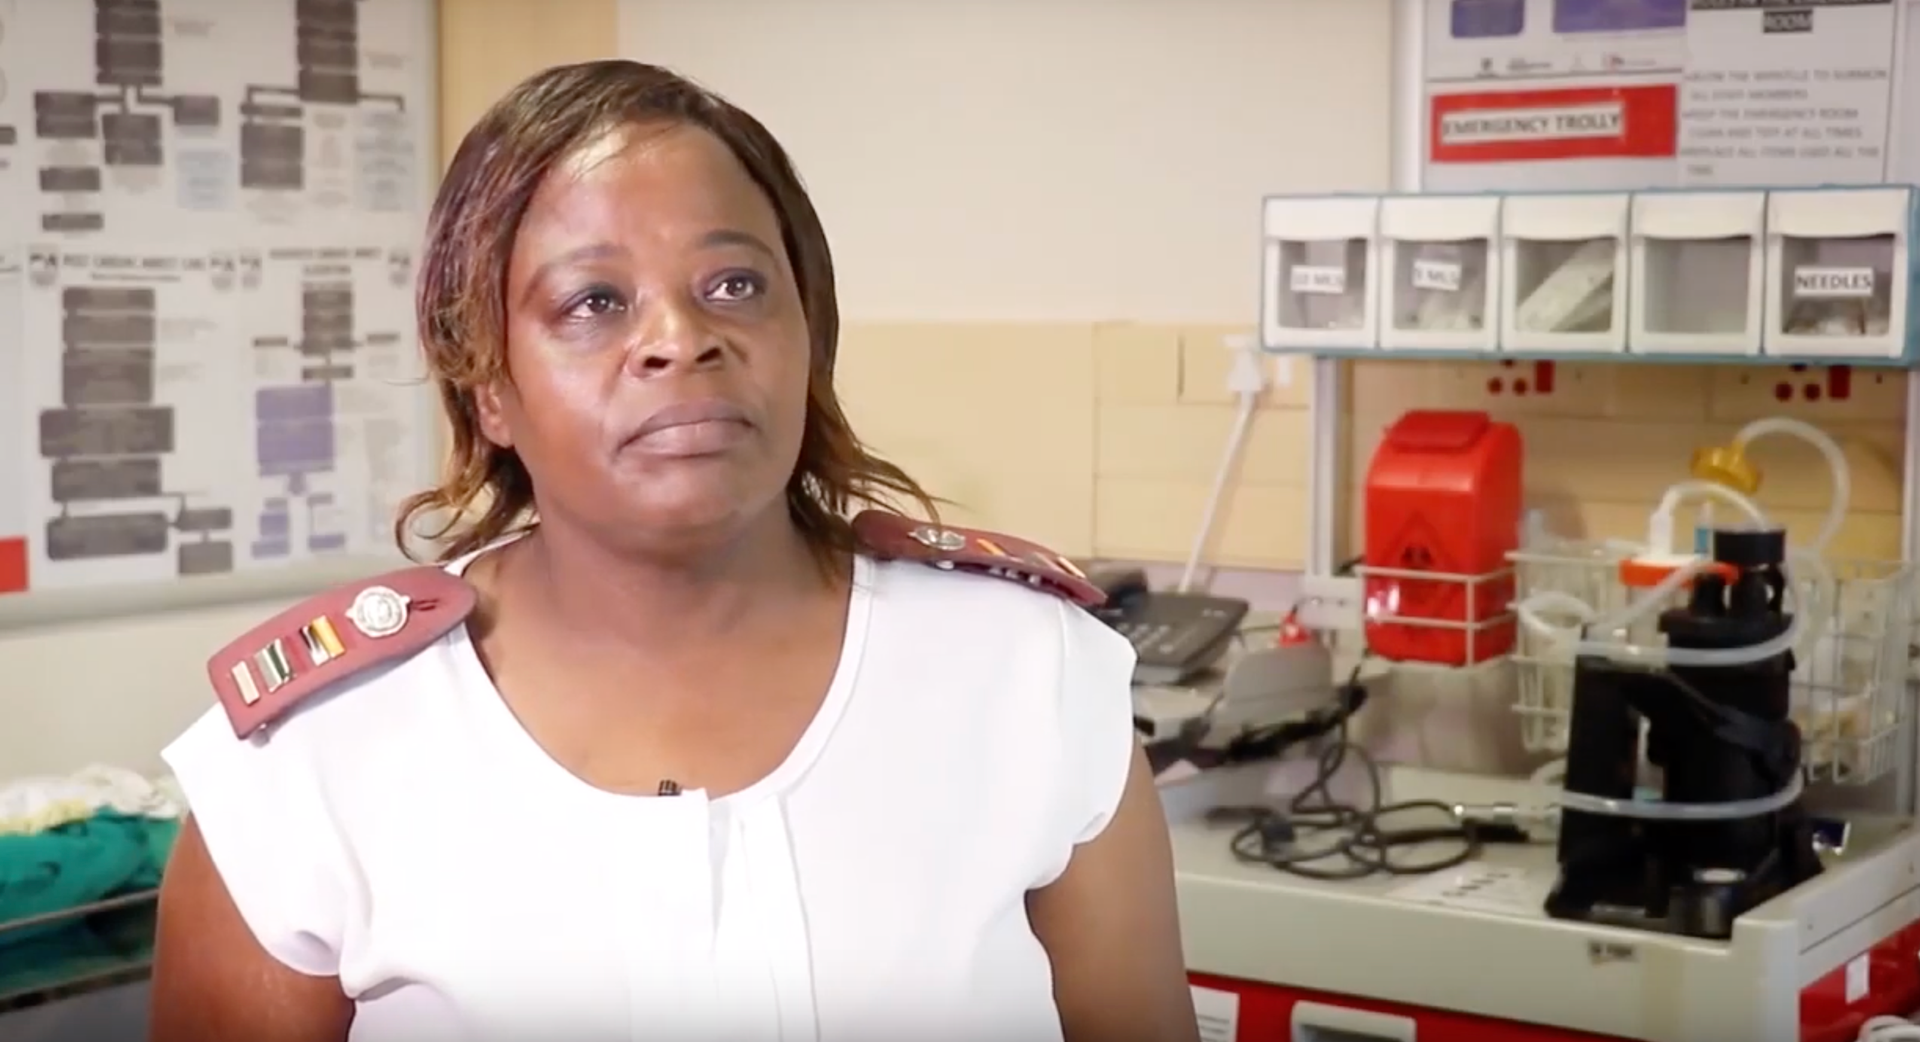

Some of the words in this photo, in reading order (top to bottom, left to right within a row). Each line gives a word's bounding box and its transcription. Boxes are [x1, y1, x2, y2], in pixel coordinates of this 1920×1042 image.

[1442, 116, 1549, 137] EMERGENCY
[1556, 112, 1621, 134] TROLLY
[1795, 273, 1872, 290] NEEDLES
